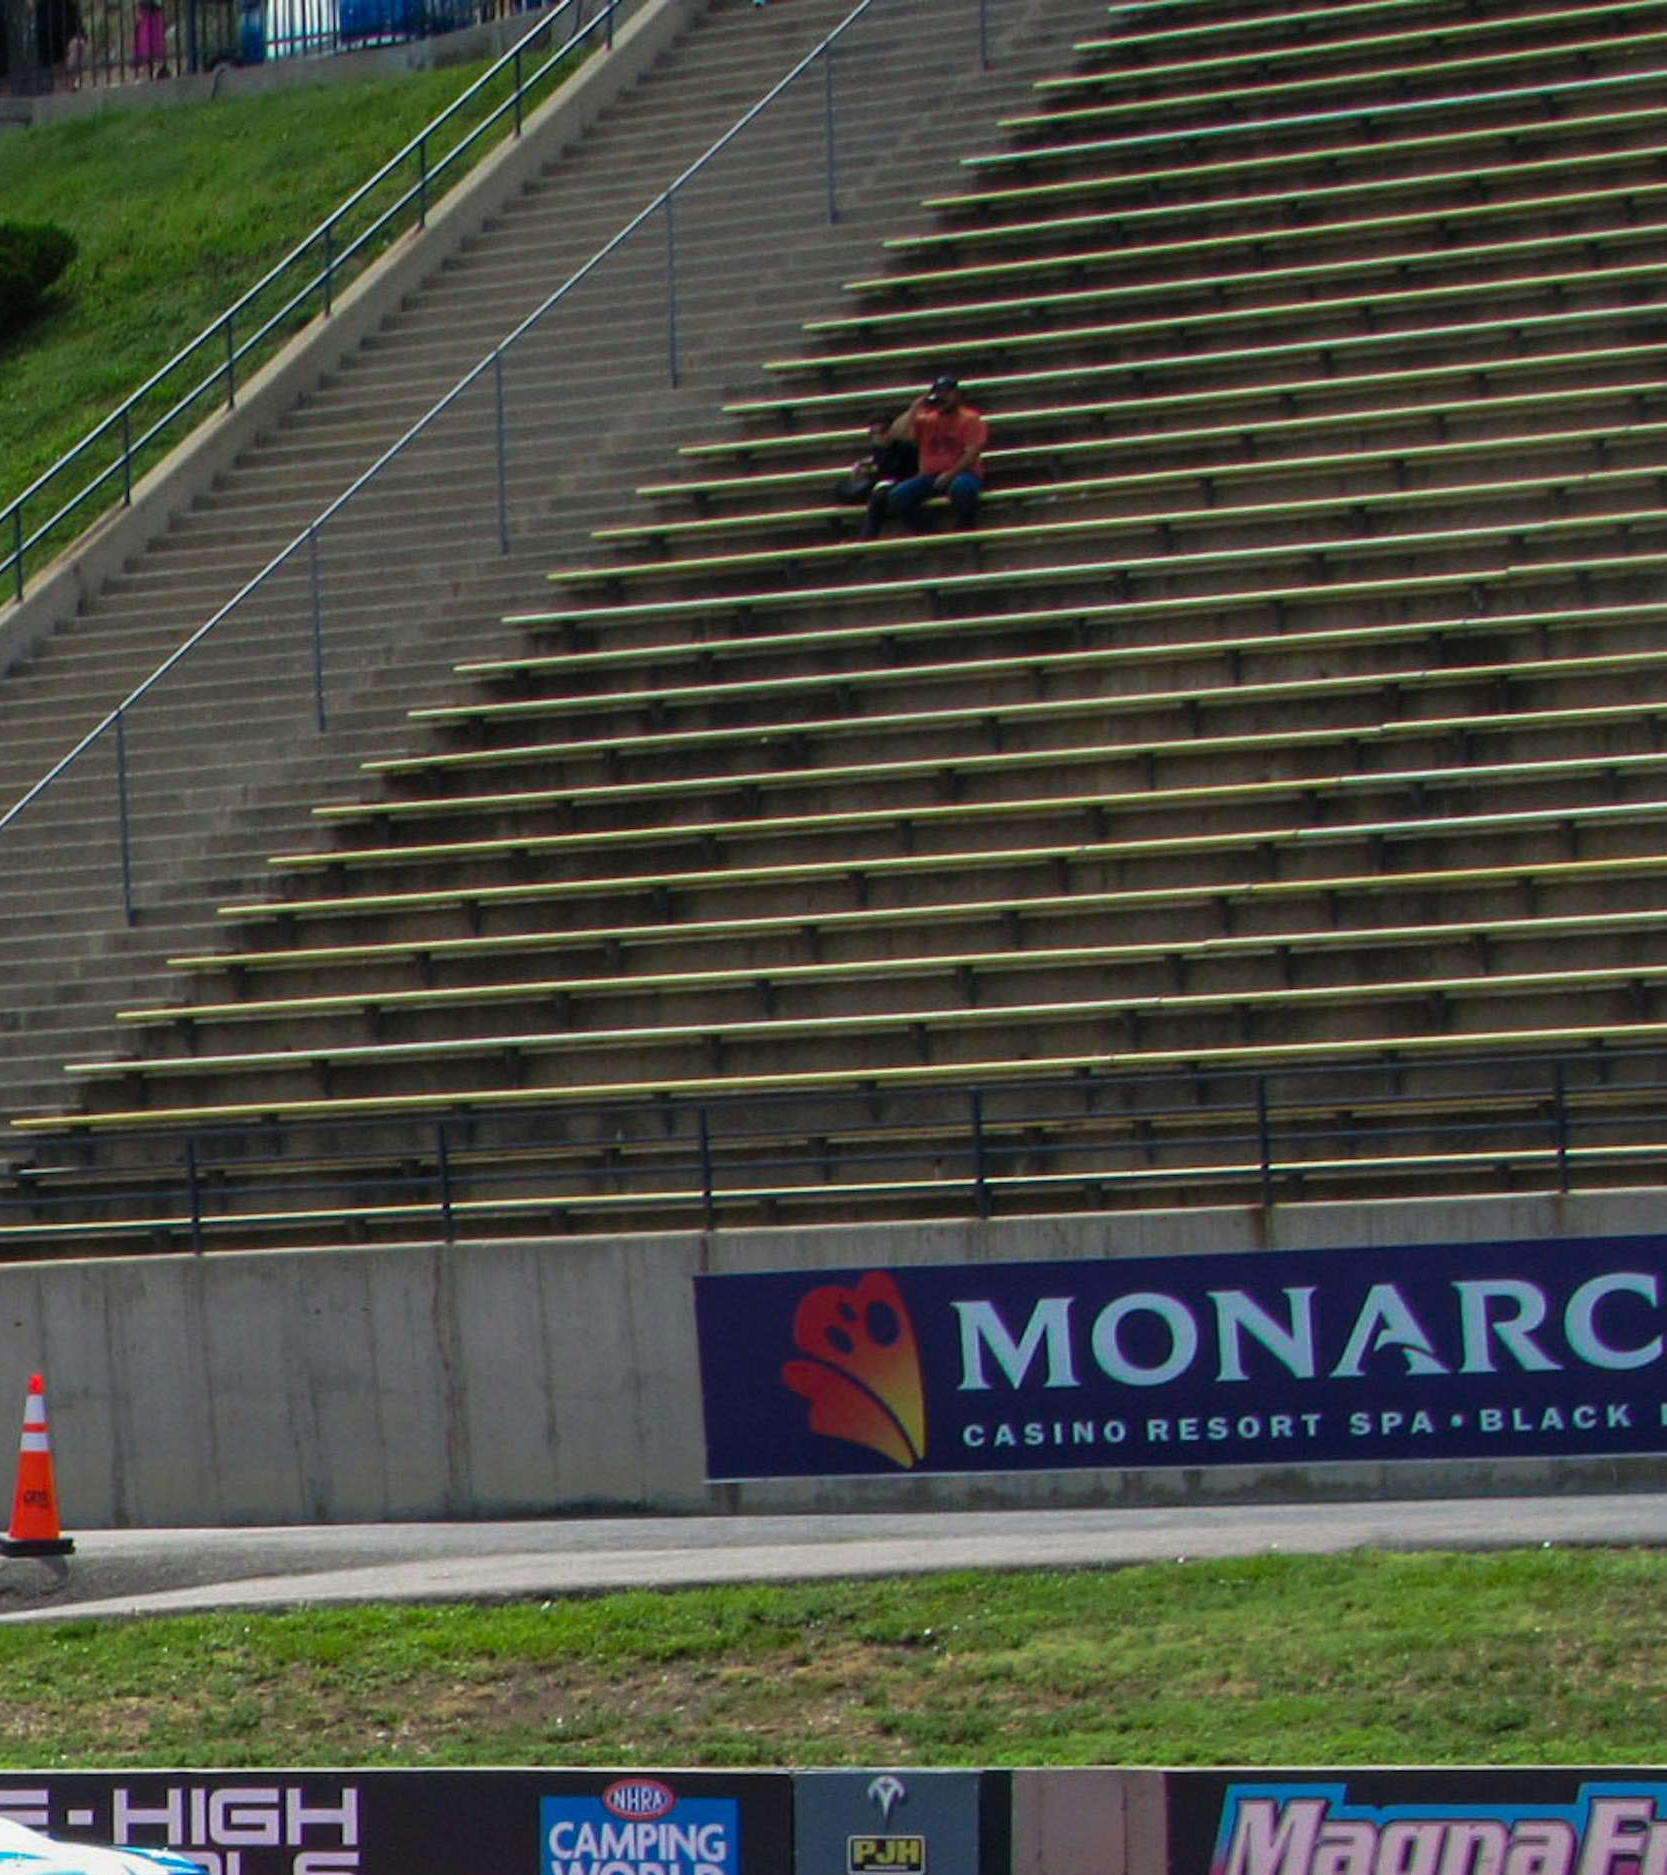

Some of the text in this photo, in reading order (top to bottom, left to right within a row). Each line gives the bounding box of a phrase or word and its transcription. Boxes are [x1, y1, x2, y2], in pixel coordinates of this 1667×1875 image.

[951, 1272, 1664, 1391] MONARC
[962, 1420, 1127, 1448] CASINO
[1147, 1414, 1323, 1443] RESORT
[1349, 1409, 1435, 1435] SPA
[1478, 1403, 1632, 1432] BLACK
[613, 1786, 664, 1813] NHRA
[549, 1821, 728, 1862] CAMPING
[853, 1840, 920, 1864] PJH
